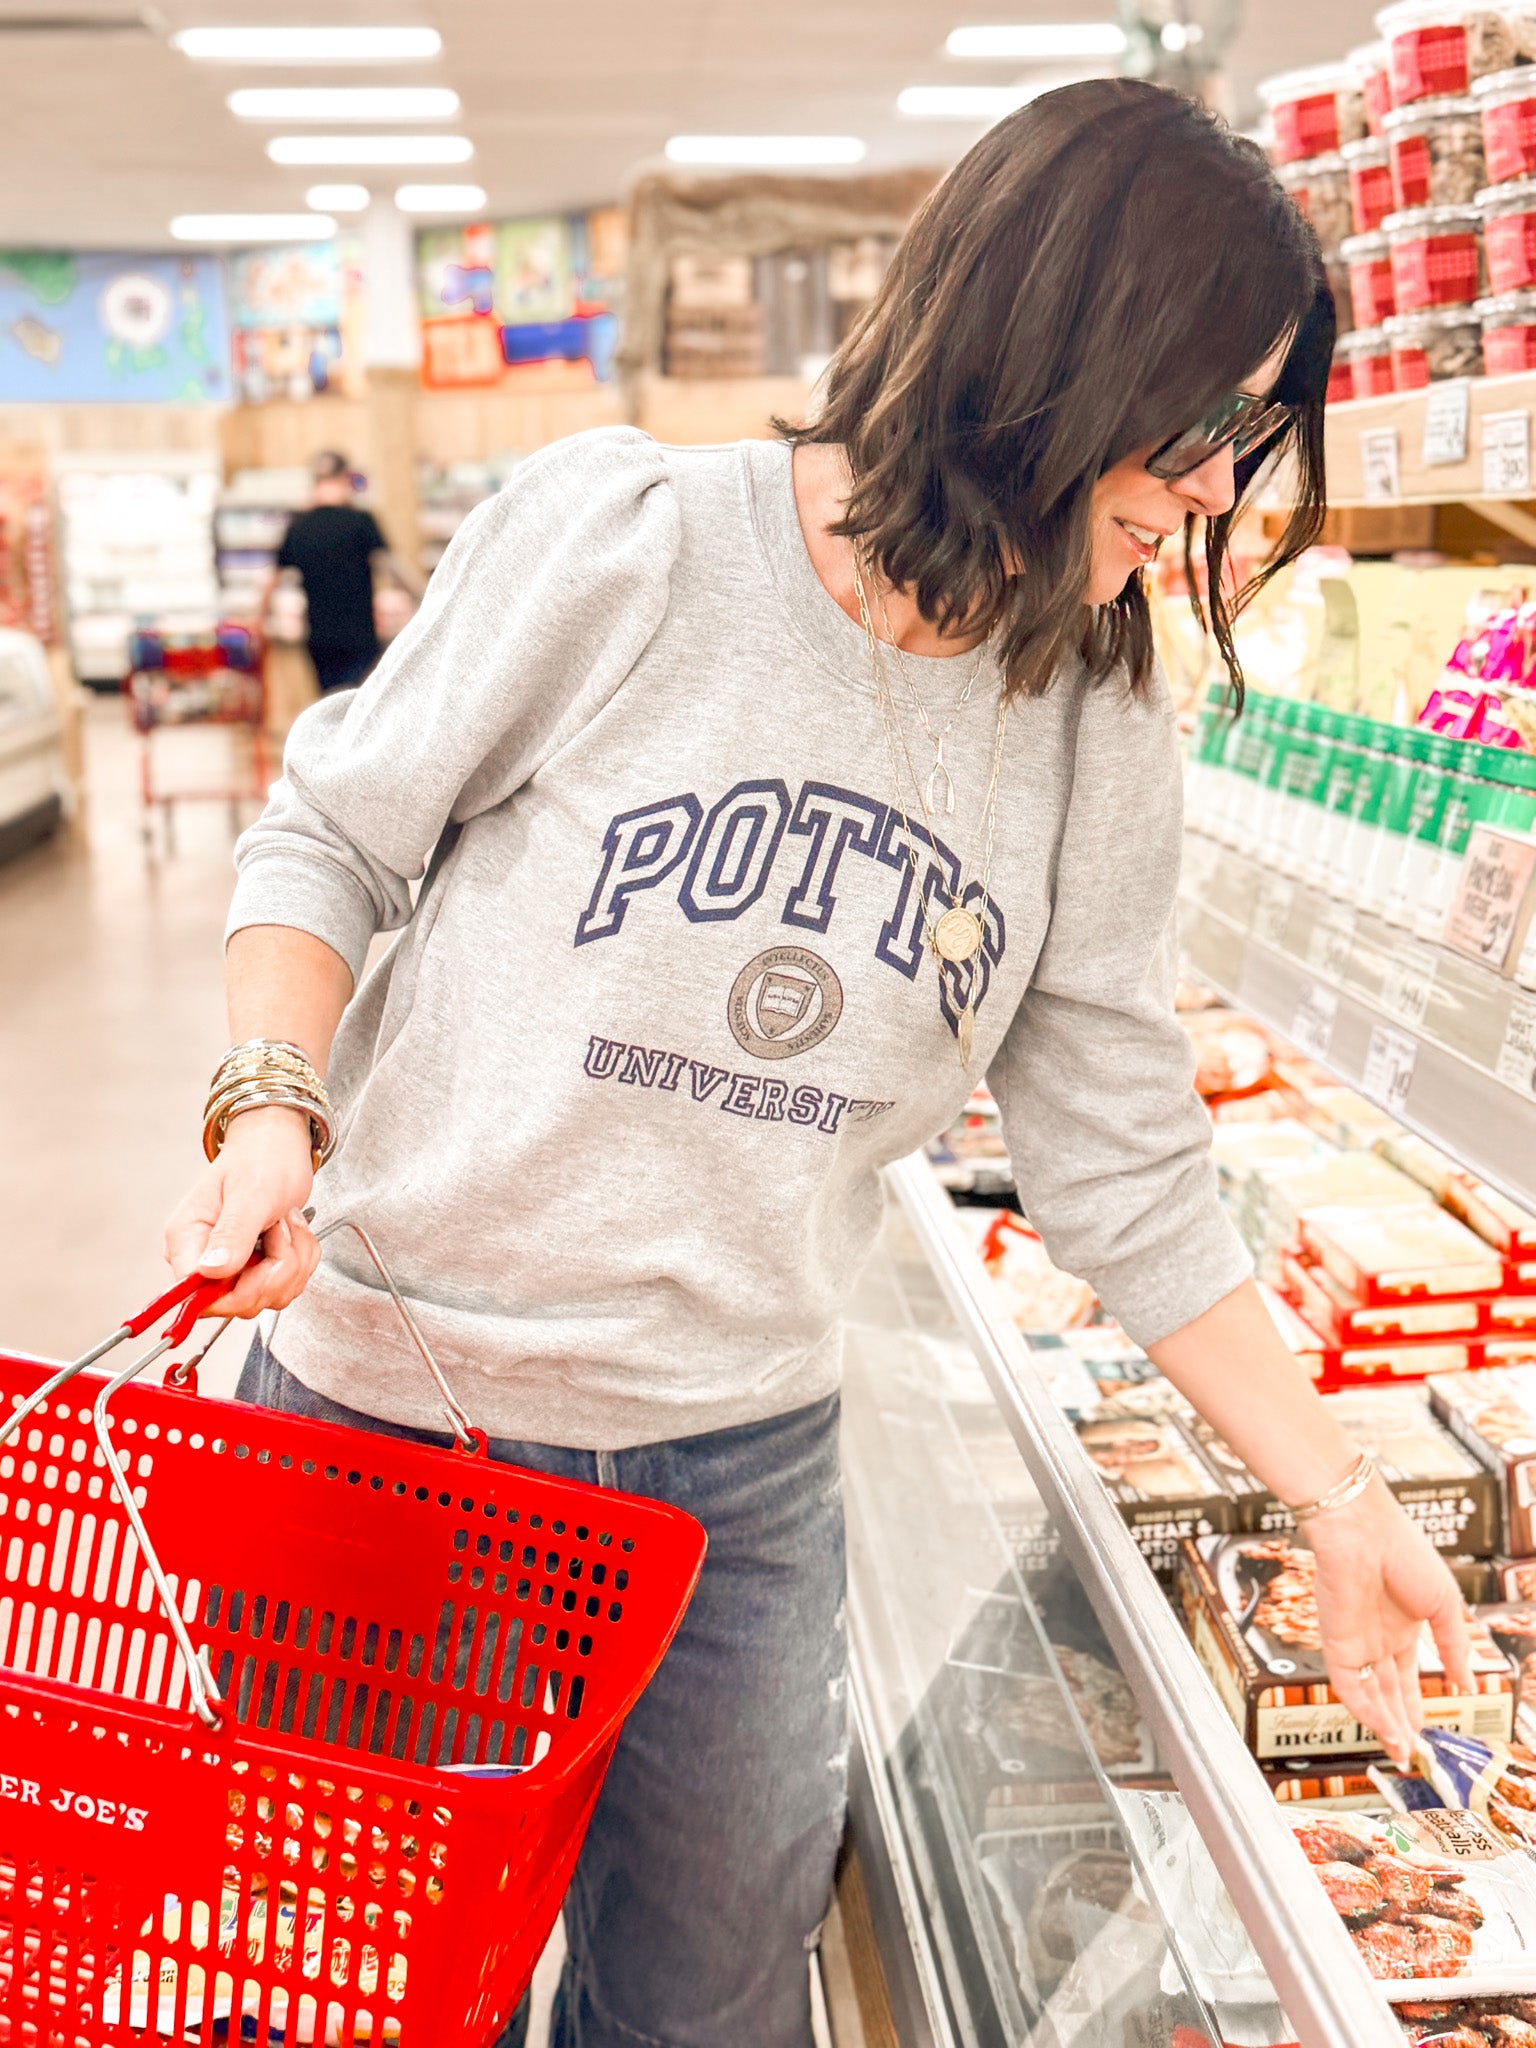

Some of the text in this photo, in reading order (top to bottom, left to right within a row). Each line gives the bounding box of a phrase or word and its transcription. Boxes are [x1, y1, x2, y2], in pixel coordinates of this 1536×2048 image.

[574, 778, 1005, 1038] POTTS
[1404, 1499, 1457, 1520] TEAK
[1131, 1520, 1193, 1541] STEAK
[1140, 1538, 1178, 1555] STO
[1275, 1730, 1344, 1747] meat
[49, 1788, 149, 1831] JOE'S
